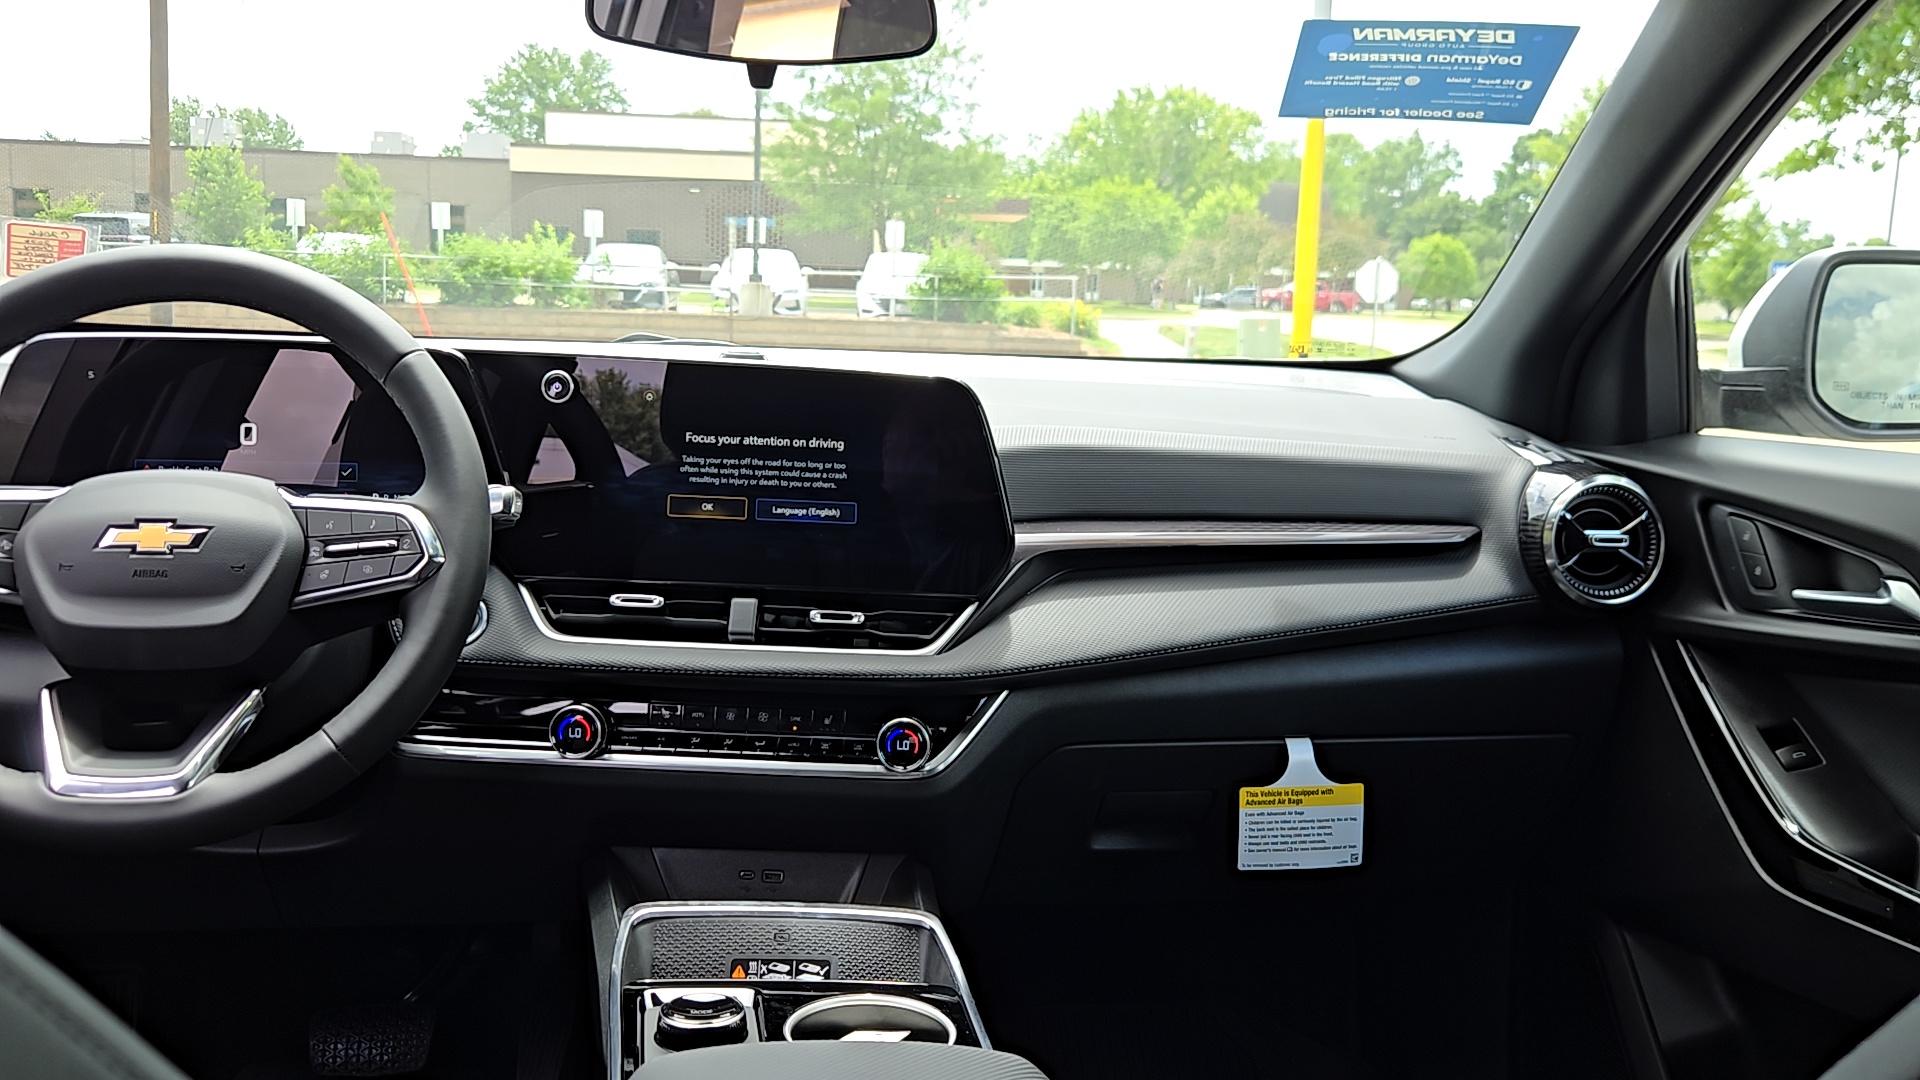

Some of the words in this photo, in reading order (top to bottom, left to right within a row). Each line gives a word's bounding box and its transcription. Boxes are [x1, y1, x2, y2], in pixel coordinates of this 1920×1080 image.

[1850, 391, 1888, 400] OBJECTS
[239, 422, 257, 446] 0
[686, 432, 716, 444] Focus
[717, 434, 740, 447] your
[743, 435, 791, 448] attention
[793, 438, 806, 448] on
[809, 437, 845, 451] driving
[681, 455, 704, 465] Taking
[706, 457, 722, 466] your
[723, 458, 739, 466] eyes
[740, 457, 752, 466] off
[765, 459, 781, 467] road
[807, 460, 823, 470] long
[720, 467, 739, 476] using
[740, 467, 753, 475] this
[754, 468, 780, 478] system
[781, 469, 800, 477] could
[828, 471, 847, 480] crash
[689, 475, 719, 485] resulting
[729, 477, 749, 487] injury
[759, 478, 779, 486] death
[789, 480, 802, 488] you
[812, 479, 837, 489] others.
[701, 502, 714, 511] OK
[772, 506, 807, 517] Language
[808, 507, 841, 518] (English)
[132, 569, 168, 579] AIRBAG
[569, 728, 581, 738] LO
[897, 740, 909, 750] LO
[1291, 789, 1319, 797] Equipped
